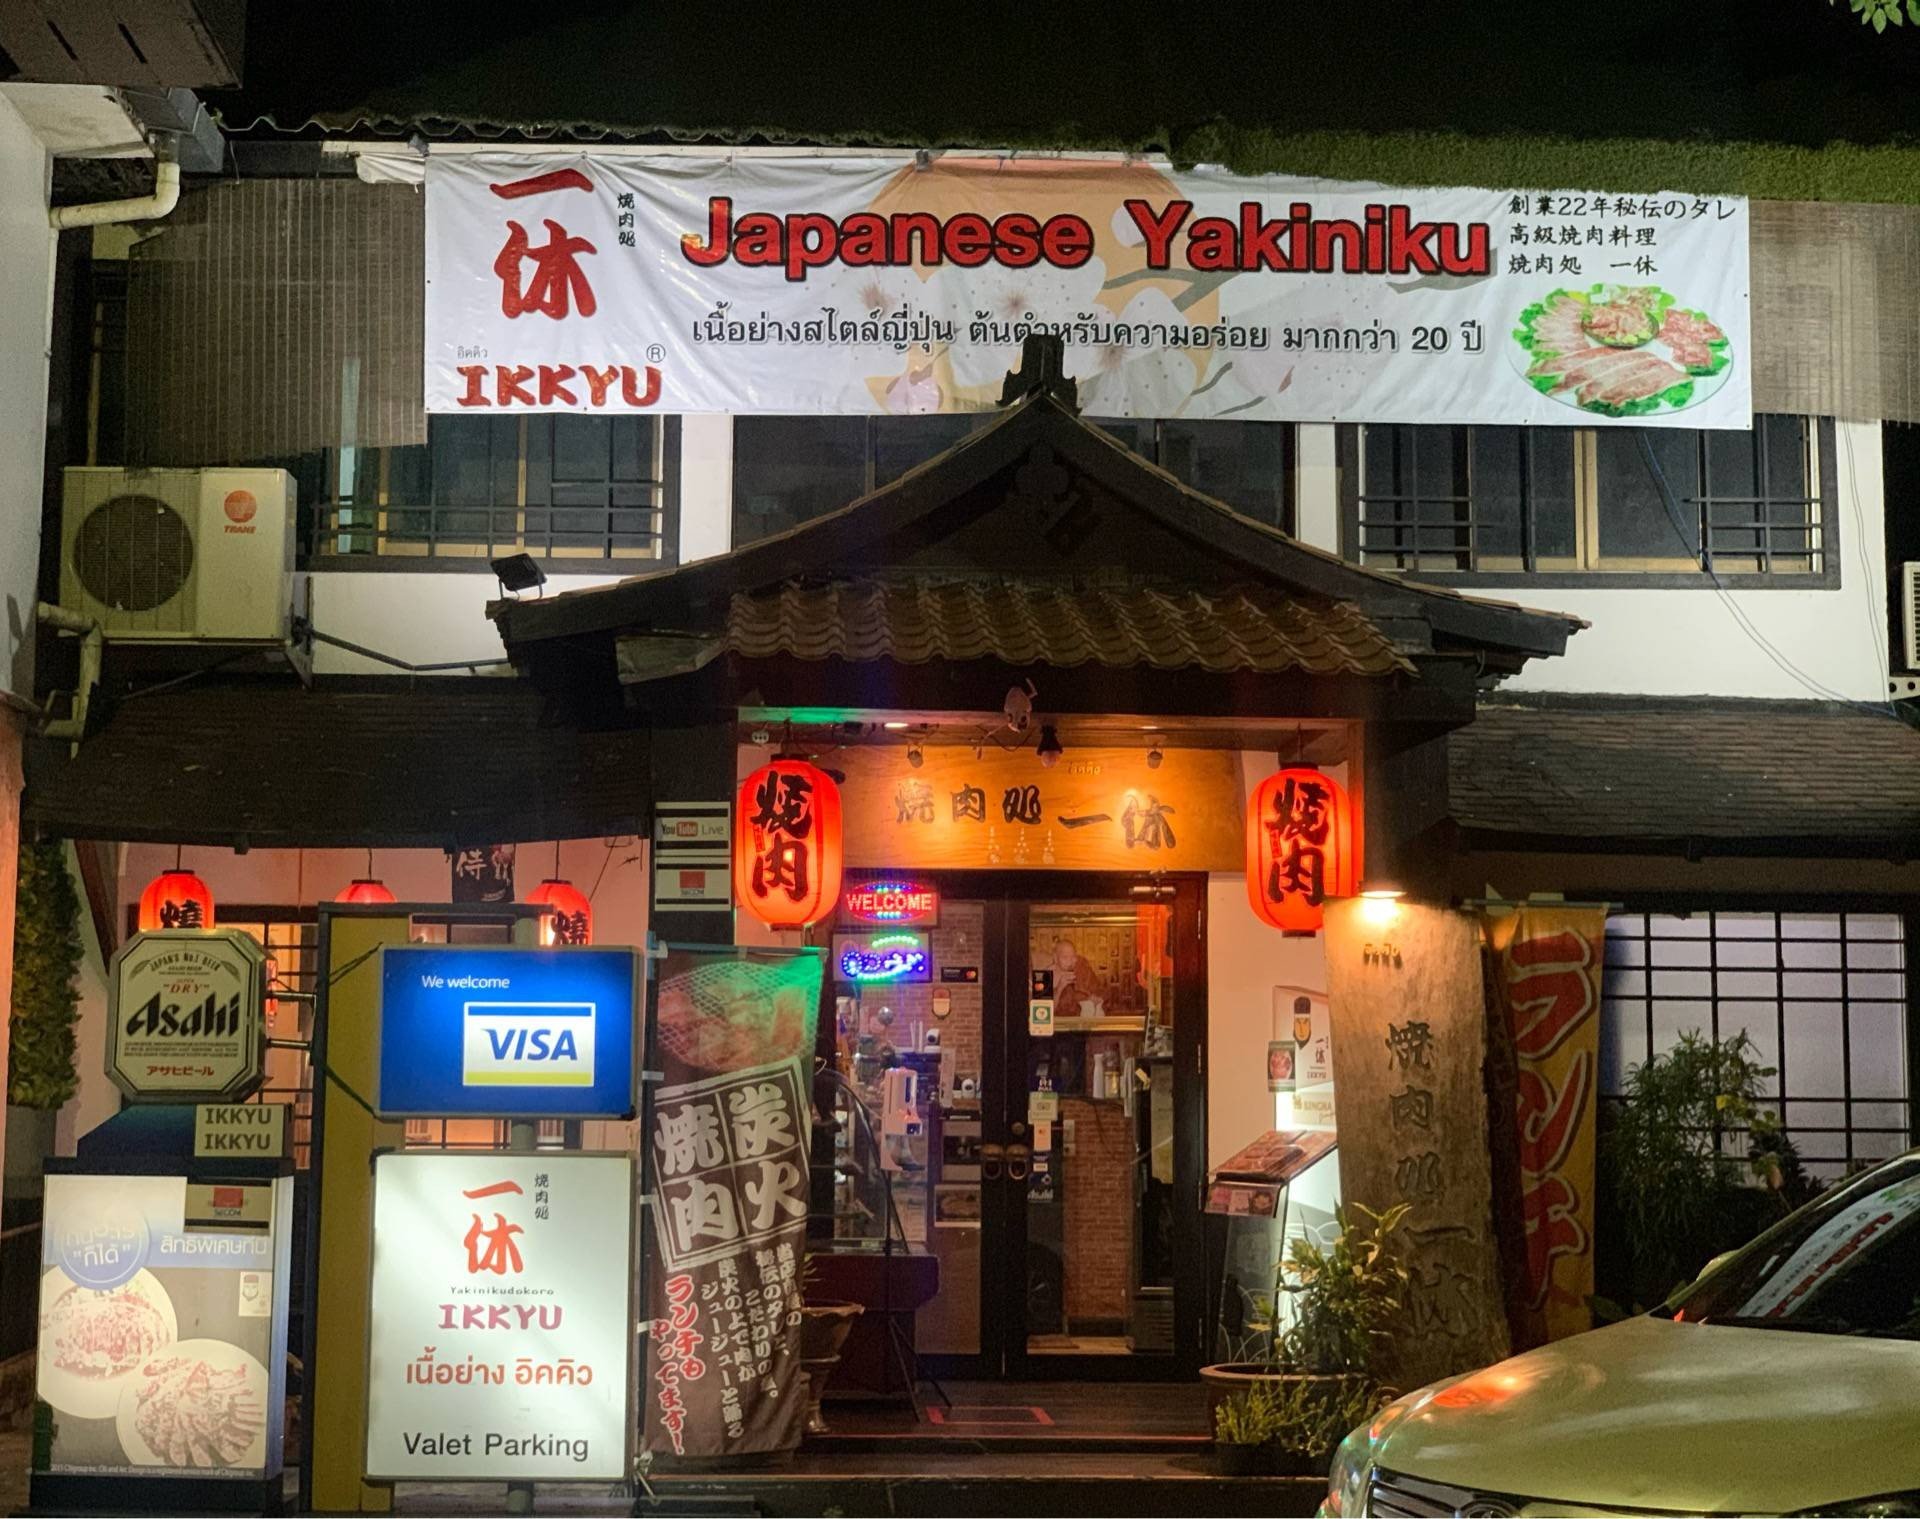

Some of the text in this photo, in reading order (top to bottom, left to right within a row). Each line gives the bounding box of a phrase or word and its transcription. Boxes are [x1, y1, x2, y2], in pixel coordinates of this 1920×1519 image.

[489, 168, 598, 320] 一休
[680, 196, 1491, 282] Japanese Yakiniku
[1509, 222, 1657, 248] 高級焼肉料理
[1508, 253, 1658, 275] 焼肉処 一休
[693, 301, 953, 353] เนื้อย่างสไตล์ญี่ปุ่น
[1283, 319, 1396, 350] มากกว่า
[1411, 326, 1448, 350] 20
[1461, 320, 1482, 351] ปี
[456, 364, 662, 407] IKKYU
[846, 893, 933, 911] WELCOME
[421, 975, 511, 989] We welcome
[125, 992, 241, 1038] Asahi
[481, 1029, 578, 1061] VISA
[146, 1065, 214, 1077] アサヒビール
[205, 1108, 272, 1124] IKKYU
[204, 1133, 271, 1149] IKKYU
[463, 1180, 524, 1275] 一休
[450, 1286, 555, 1296] Yakinikudokoro
[438, 1303, 562, 1330] IKKYU
[406, 1346, 593, 1385] เนื้อย่าง อิคคิว
[403, 1432, 589, 1462] Valet Parking
